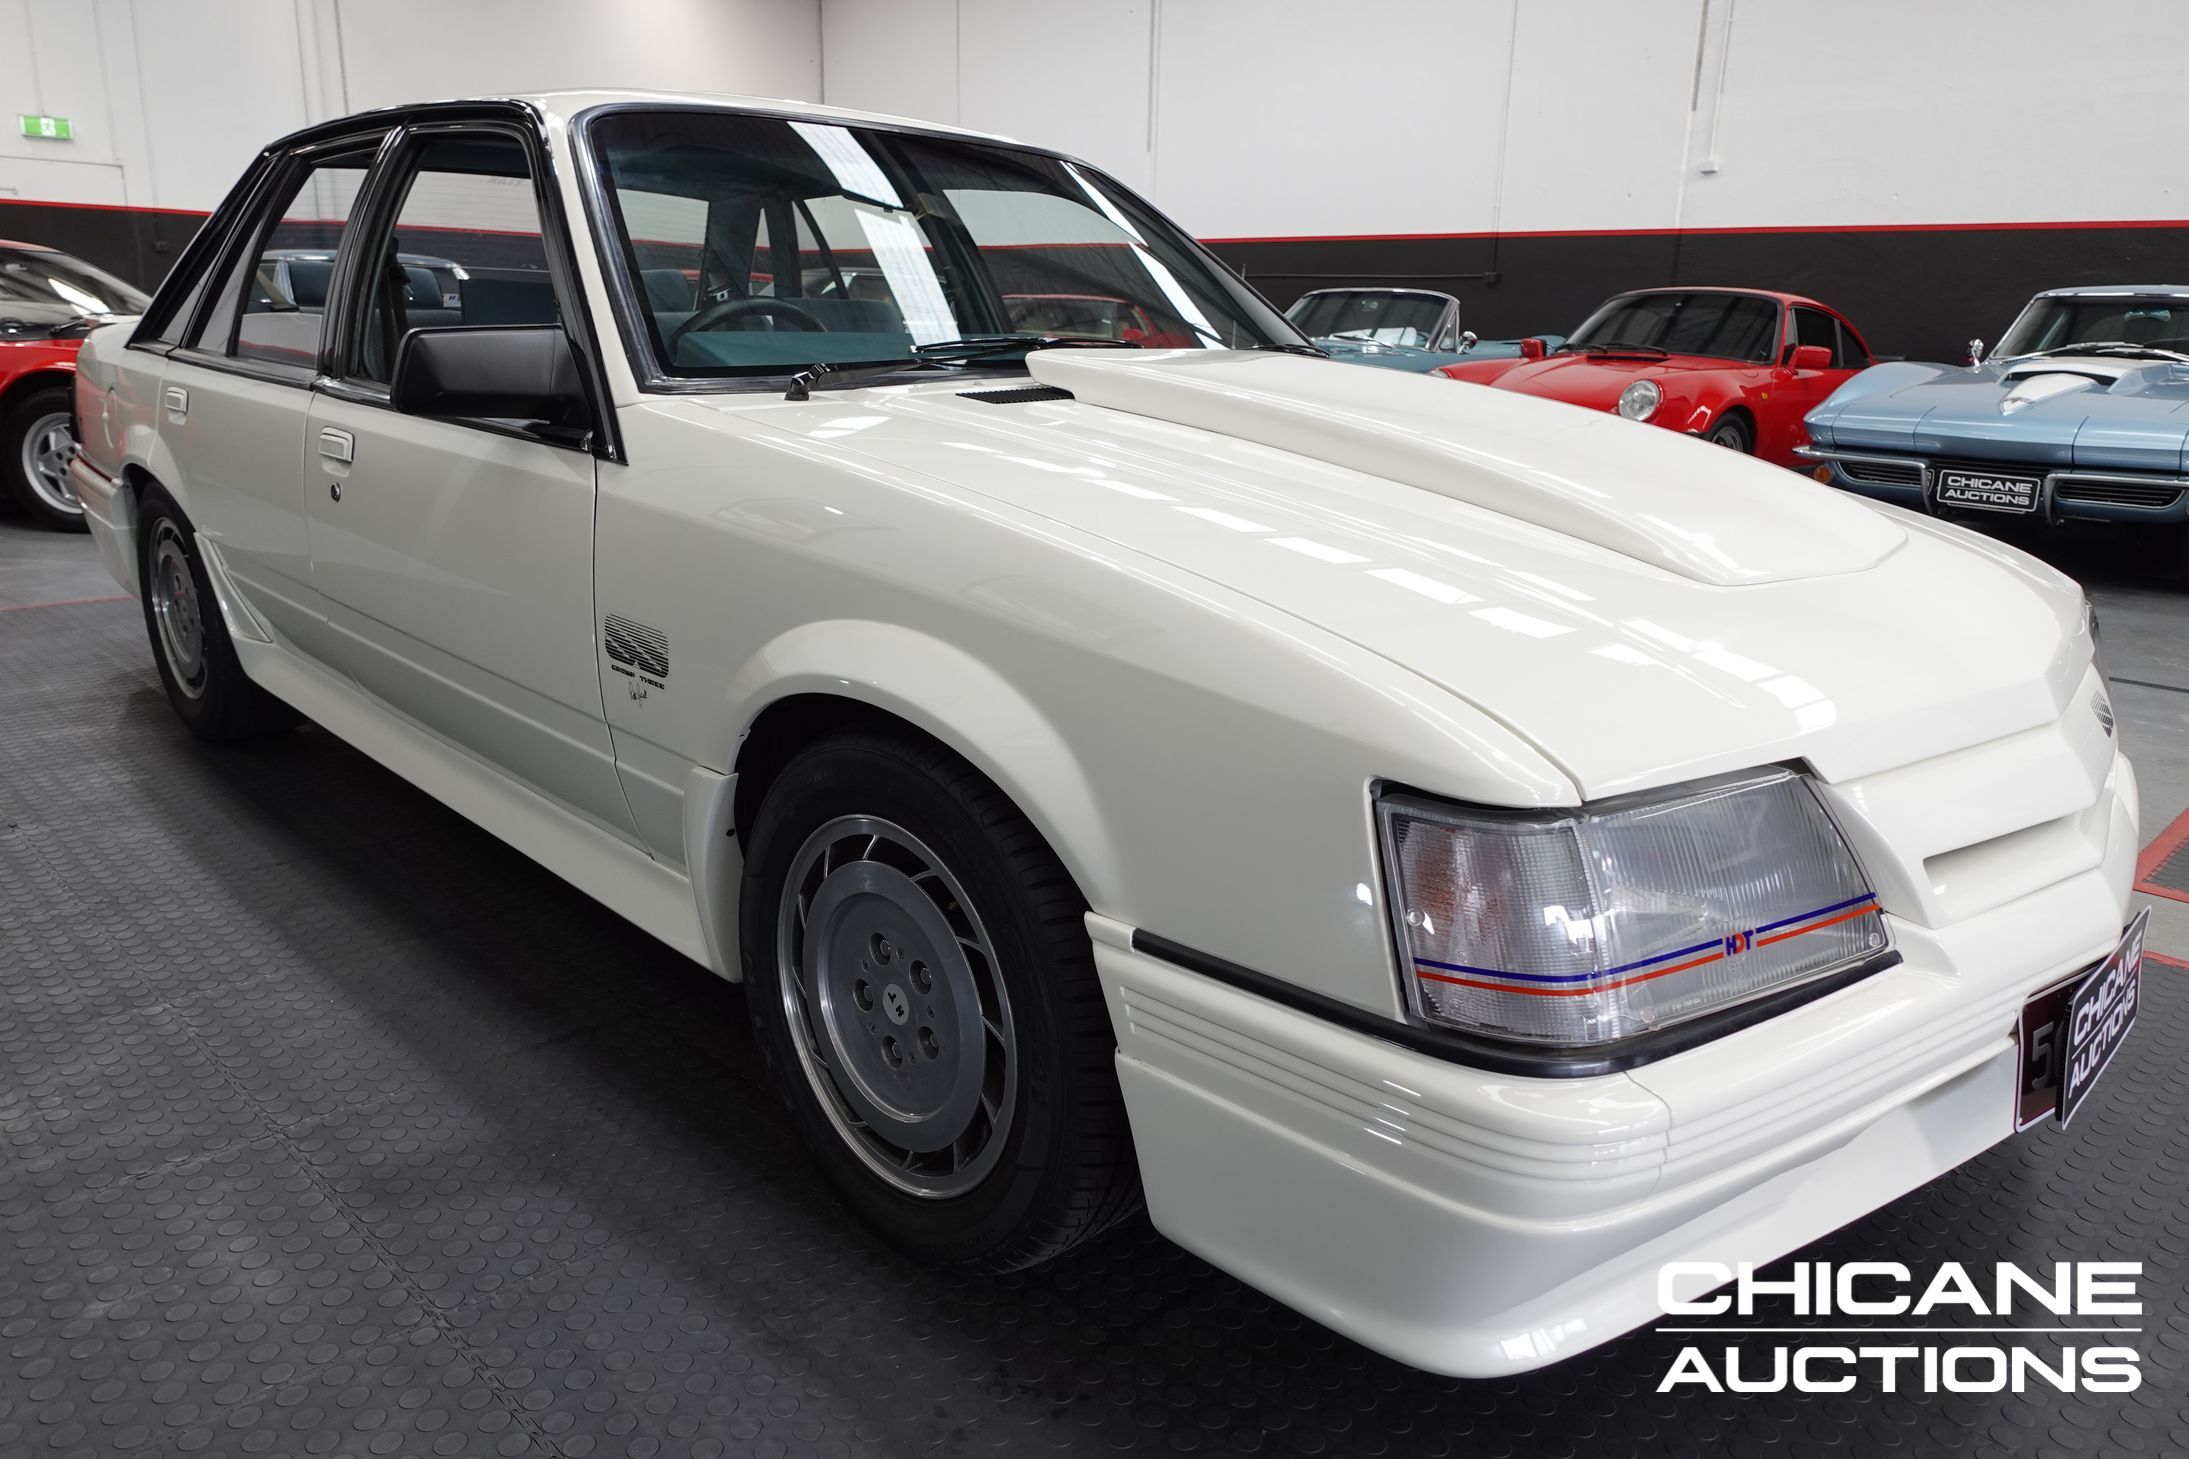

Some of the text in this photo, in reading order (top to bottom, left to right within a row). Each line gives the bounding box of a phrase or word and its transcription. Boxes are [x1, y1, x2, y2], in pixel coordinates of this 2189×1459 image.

[1945, 489, 2030, 506] AUCTIONS
[1947, 476, 2033, 494] CHICANE
[1726, 929, 1754, 956] HDT
[2073, 929, 2143, 1047] CHICANE
[2067, 979, 2136, 1099] AUCTIONS
